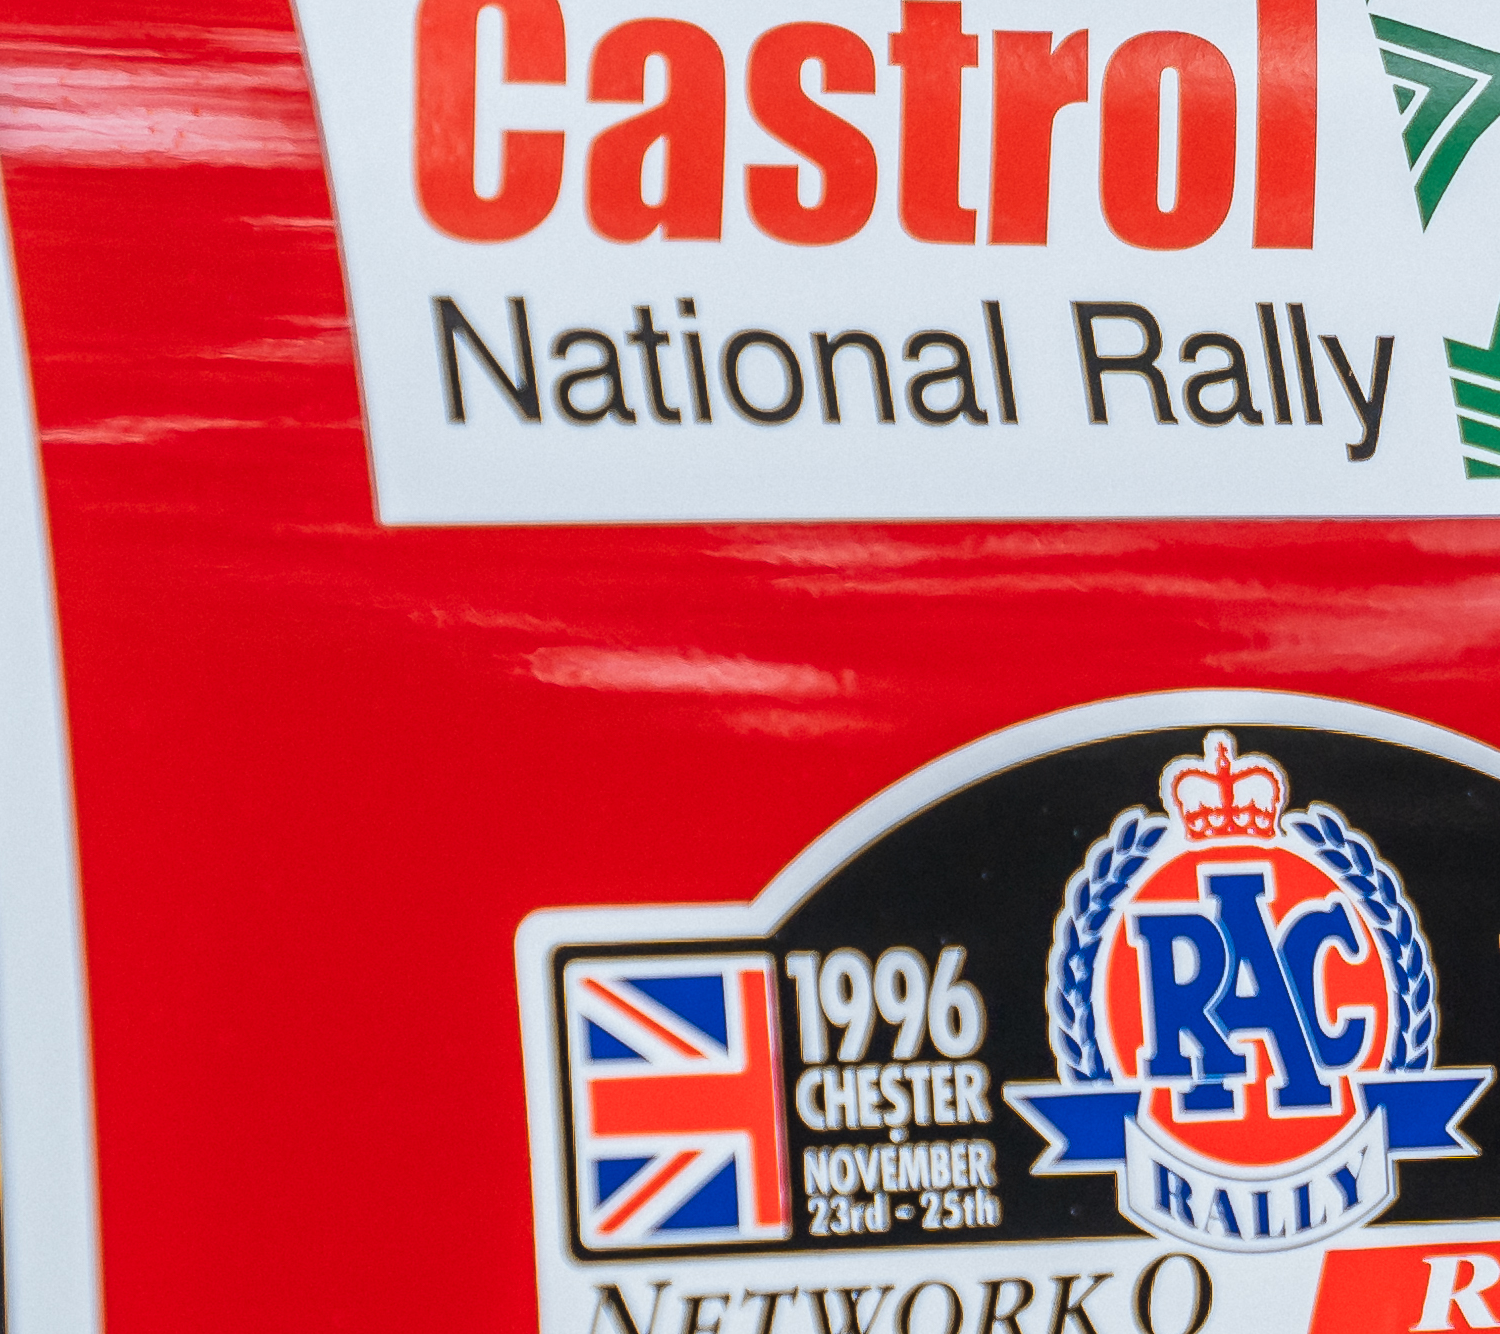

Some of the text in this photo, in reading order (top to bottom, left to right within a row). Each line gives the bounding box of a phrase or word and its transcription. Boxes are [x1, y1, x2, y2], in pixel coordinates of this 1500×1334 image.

[432, 297, 1394, 463] National Rally
[785, 944, 988, 1064] 1996
[1137, 872, 1368, 1112] RAC
[795, 1060, 993, 1131] CHESTER
[803, 1138, 998, 1197] NOVEMBER
[807, 1191, 892, 1237] 23rd
[918, 1186, 1003, 1231] 25th
[1152, 1142, 1370, 1241] RALLY
